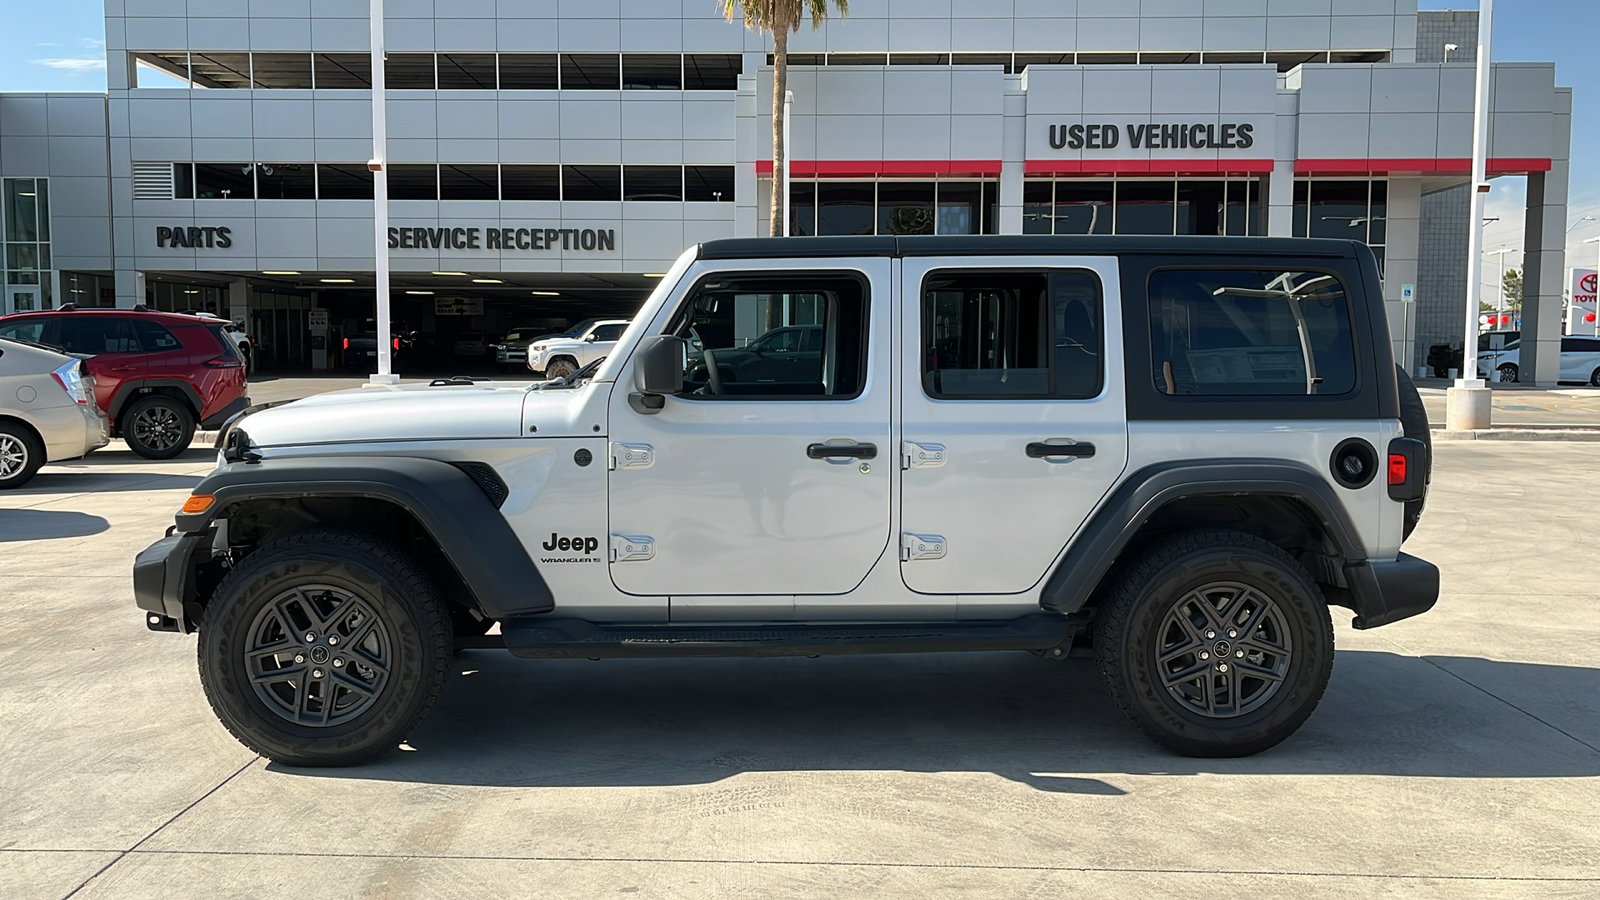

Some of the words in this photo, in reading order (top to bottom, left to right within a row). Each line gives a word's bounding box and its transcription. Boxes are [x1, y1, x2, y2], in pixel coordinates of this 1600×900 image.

[1049, 124, 1120, 149] USED
[1127, 123, 1254, 149] VEHICLES
[156, 226, 232, 248] PARTS
[387, 227, 480, 249] SERVICE
[486, 228, 615, 251] RECEPTION
[542, 532, 599, 555] Jeep
